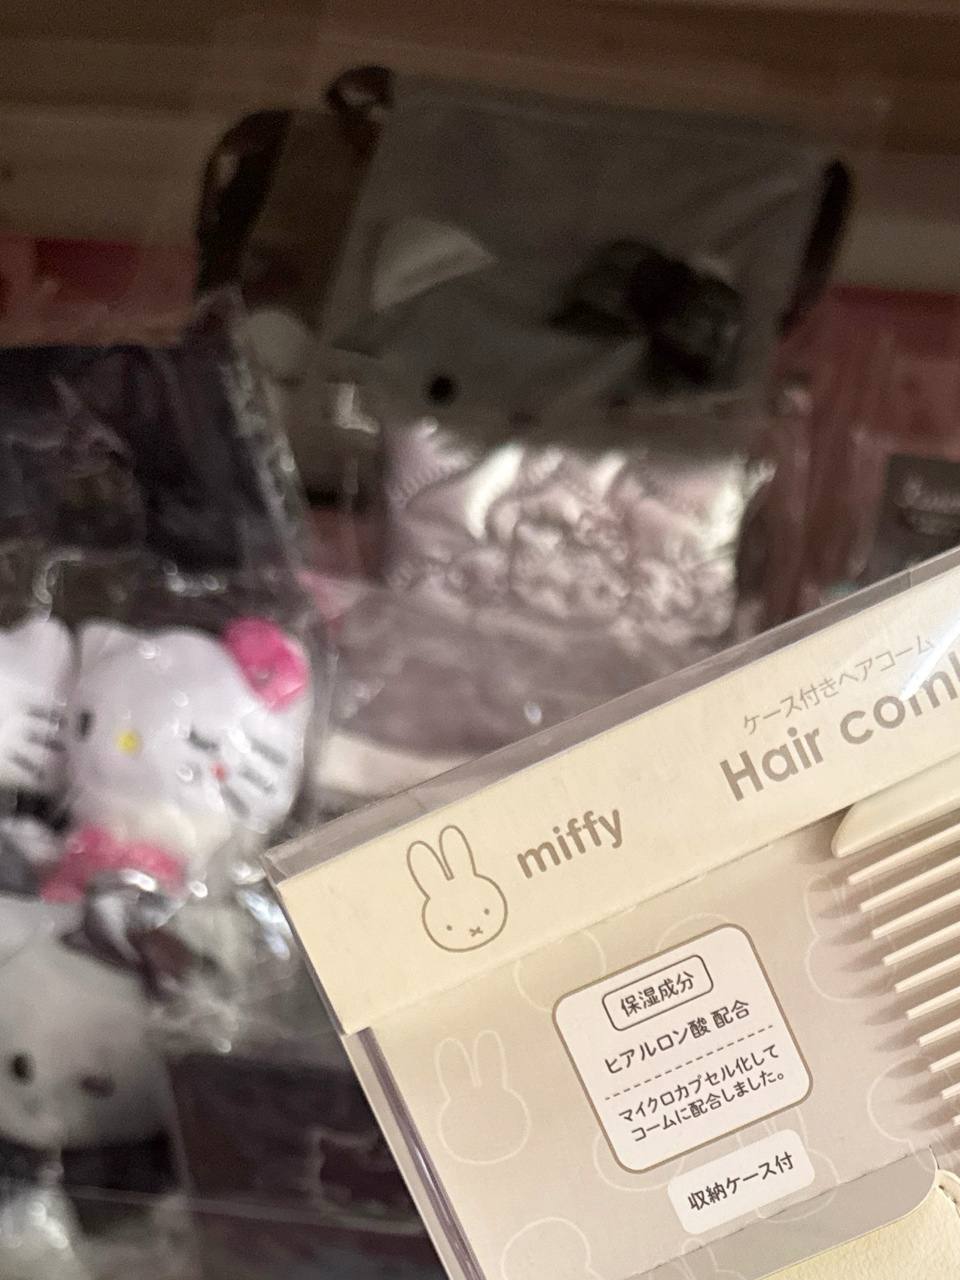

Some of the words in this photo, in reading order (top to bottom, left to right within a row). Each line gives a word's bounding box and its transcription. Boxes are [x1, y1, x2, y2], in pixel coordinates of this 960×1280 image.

[743, 634, 935, 735] ケース付きヘアコーム
[719, 726, 824, 802] Hair
[516, 809, 623, 879] miffy
[620, 970, 695, 1017] 保湿成分
[604, 1017, 711, 1074] ヒアルロン酸
[712, 999, 750, 1029] 配合
[618, 1044, 780, 1123] マイクロカプセル化して
[631, 1070, 785, 1142] コームに配合しました。
[687, 1151, 795, 1211] 収納ケース付
